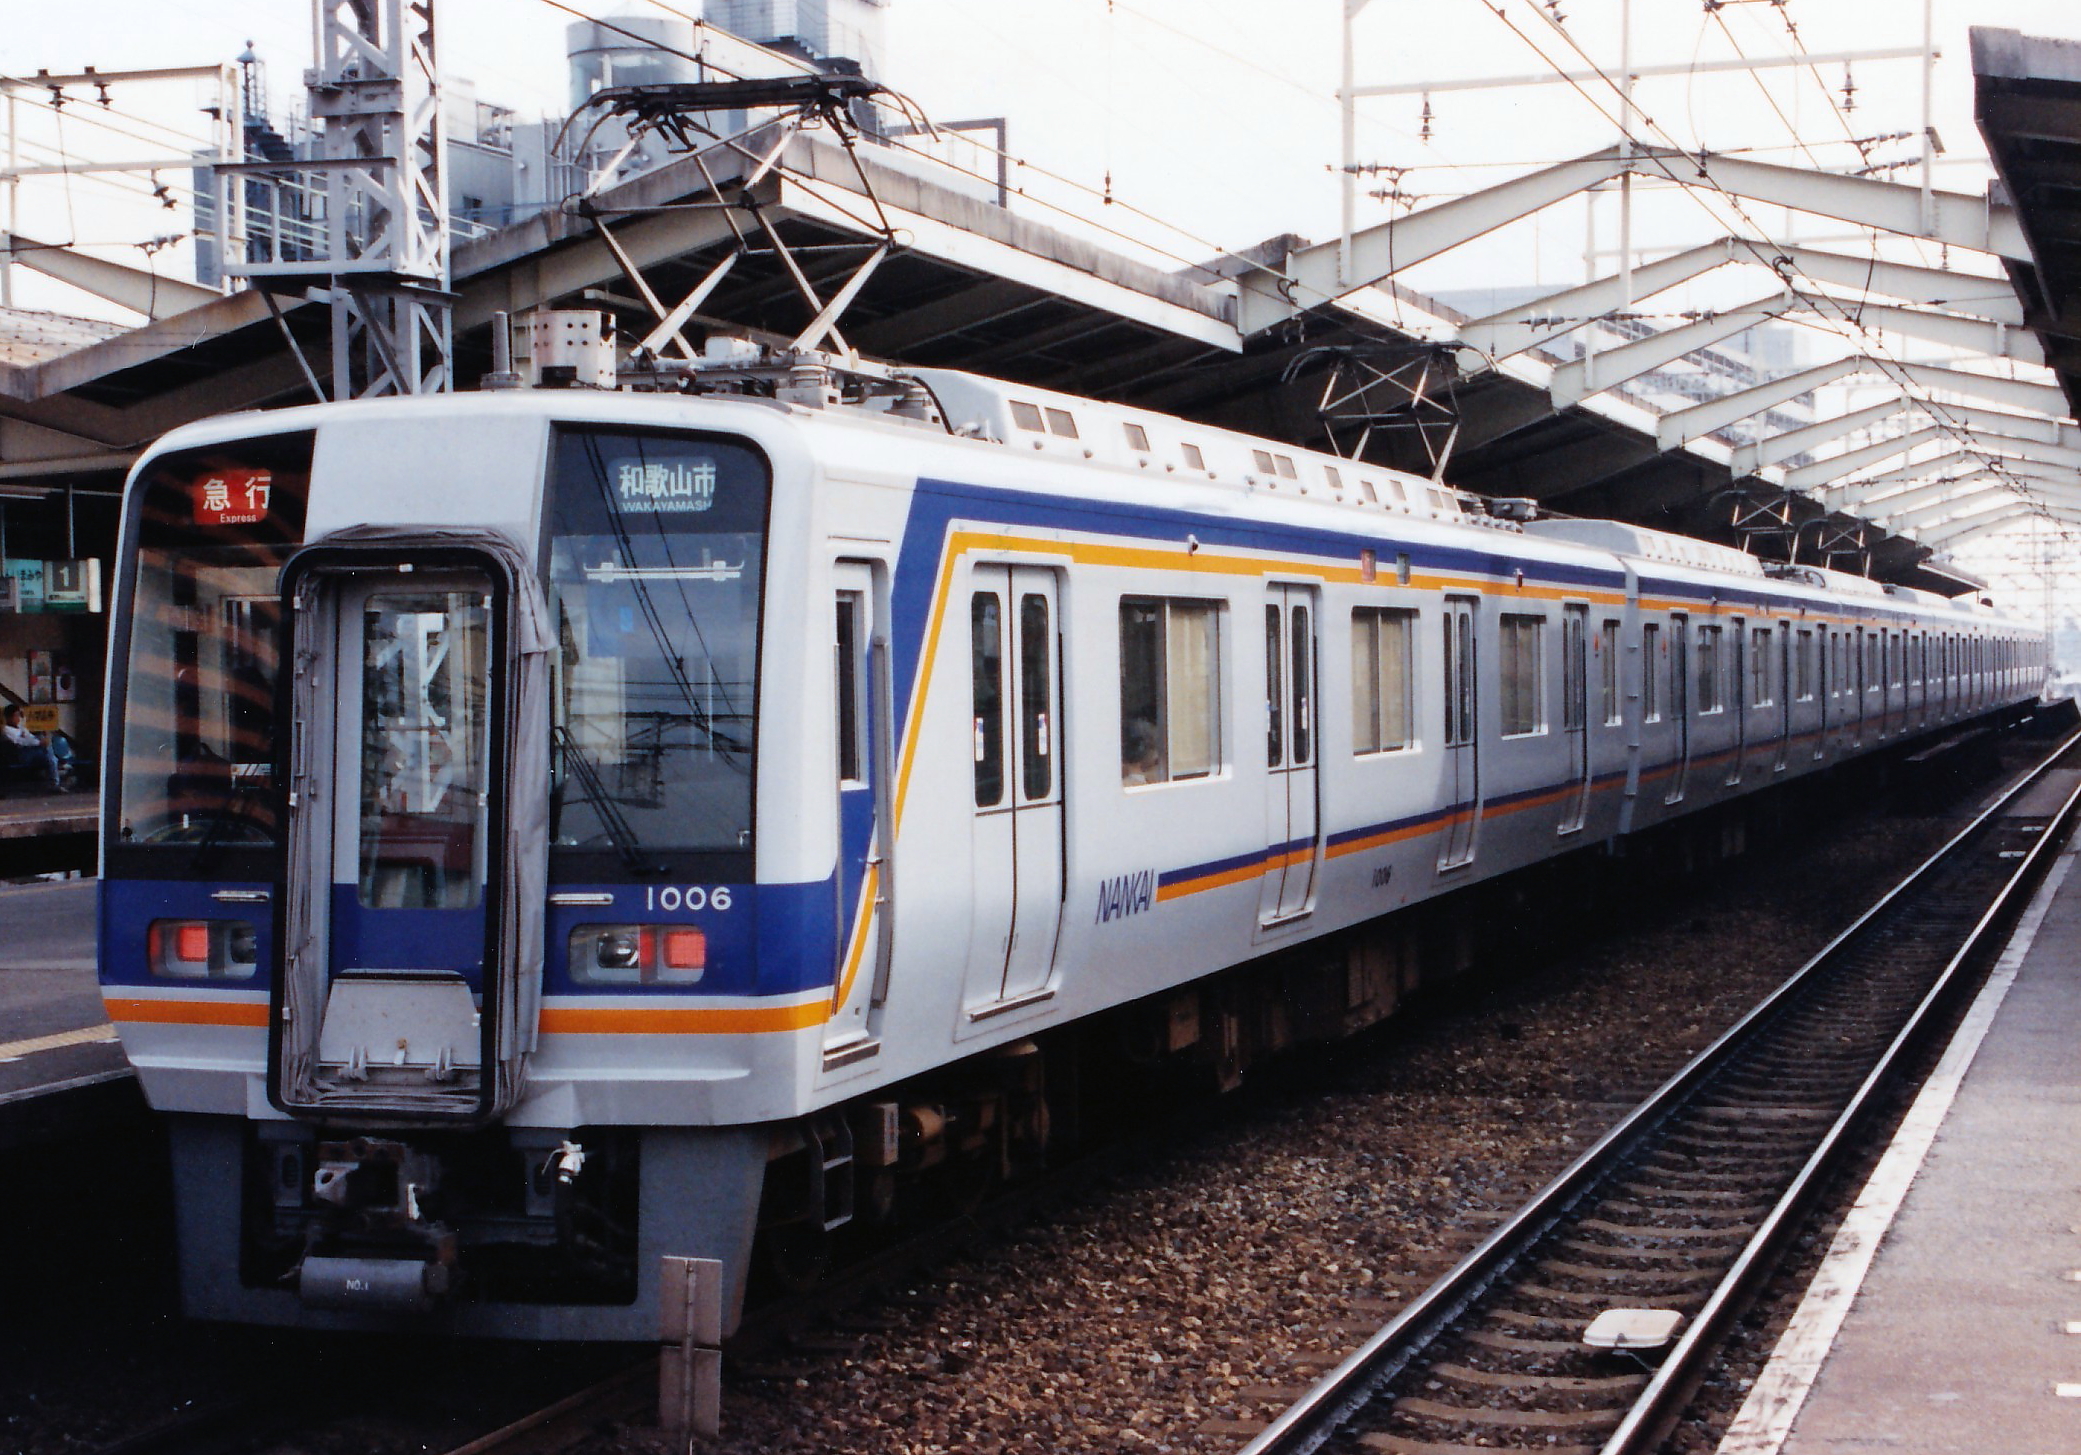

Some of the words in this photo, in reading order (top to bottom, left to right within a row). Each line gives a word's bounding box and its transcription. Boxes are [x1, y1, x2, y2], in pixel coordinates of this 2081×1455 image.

[203, 476, 271, 511] 急行
[619, 463, 716, 499] 和歌山市
[220, 513, 257, 523] Express
[622, 500, 712, 512] WAKAYAMASH
[60, 566, 70, 587] 1
[647, 886, 732, 911] 1006
[1095, 868, 1154, 925] NANKAI
